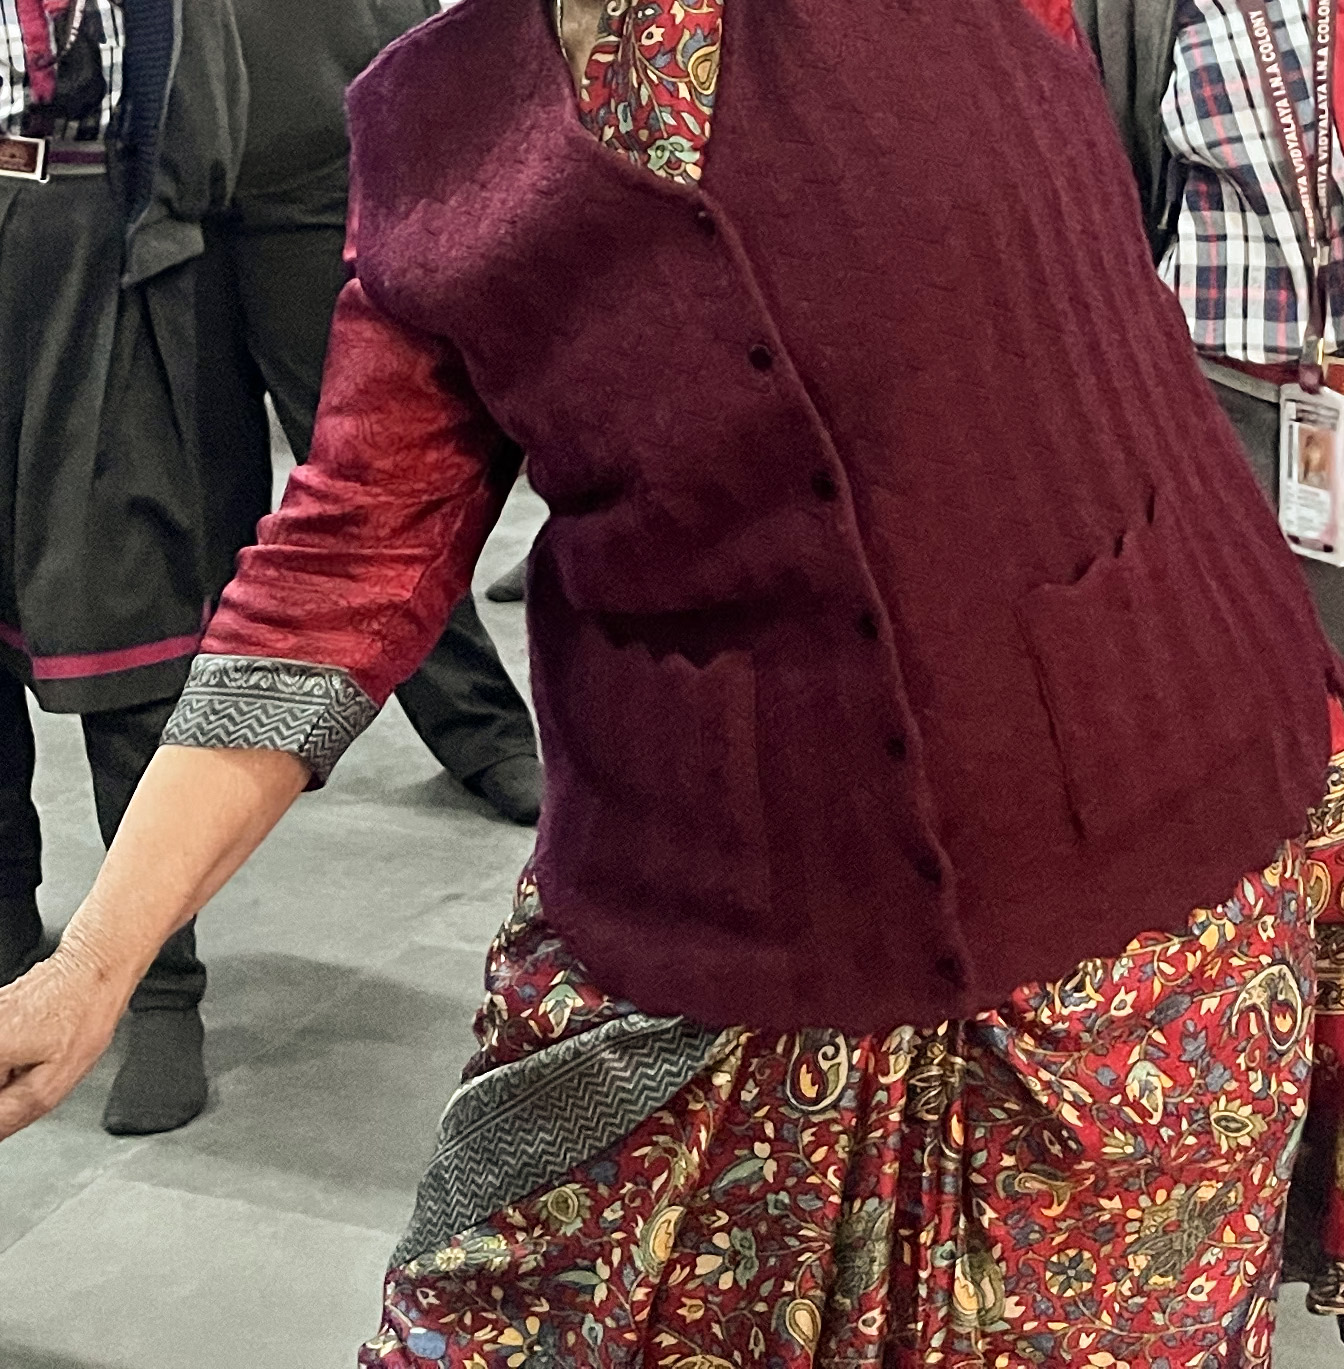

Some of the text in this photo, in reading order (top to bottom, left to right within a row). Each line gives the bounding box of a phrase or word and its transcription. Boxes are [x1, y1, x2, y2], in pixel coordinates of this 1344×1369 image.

[1249, 10, 1277, 62] COLONY
[1275, 97, 1306, 173] VIDYALAYA
[1317, 83, 1329, 162] VIDYALAYA
